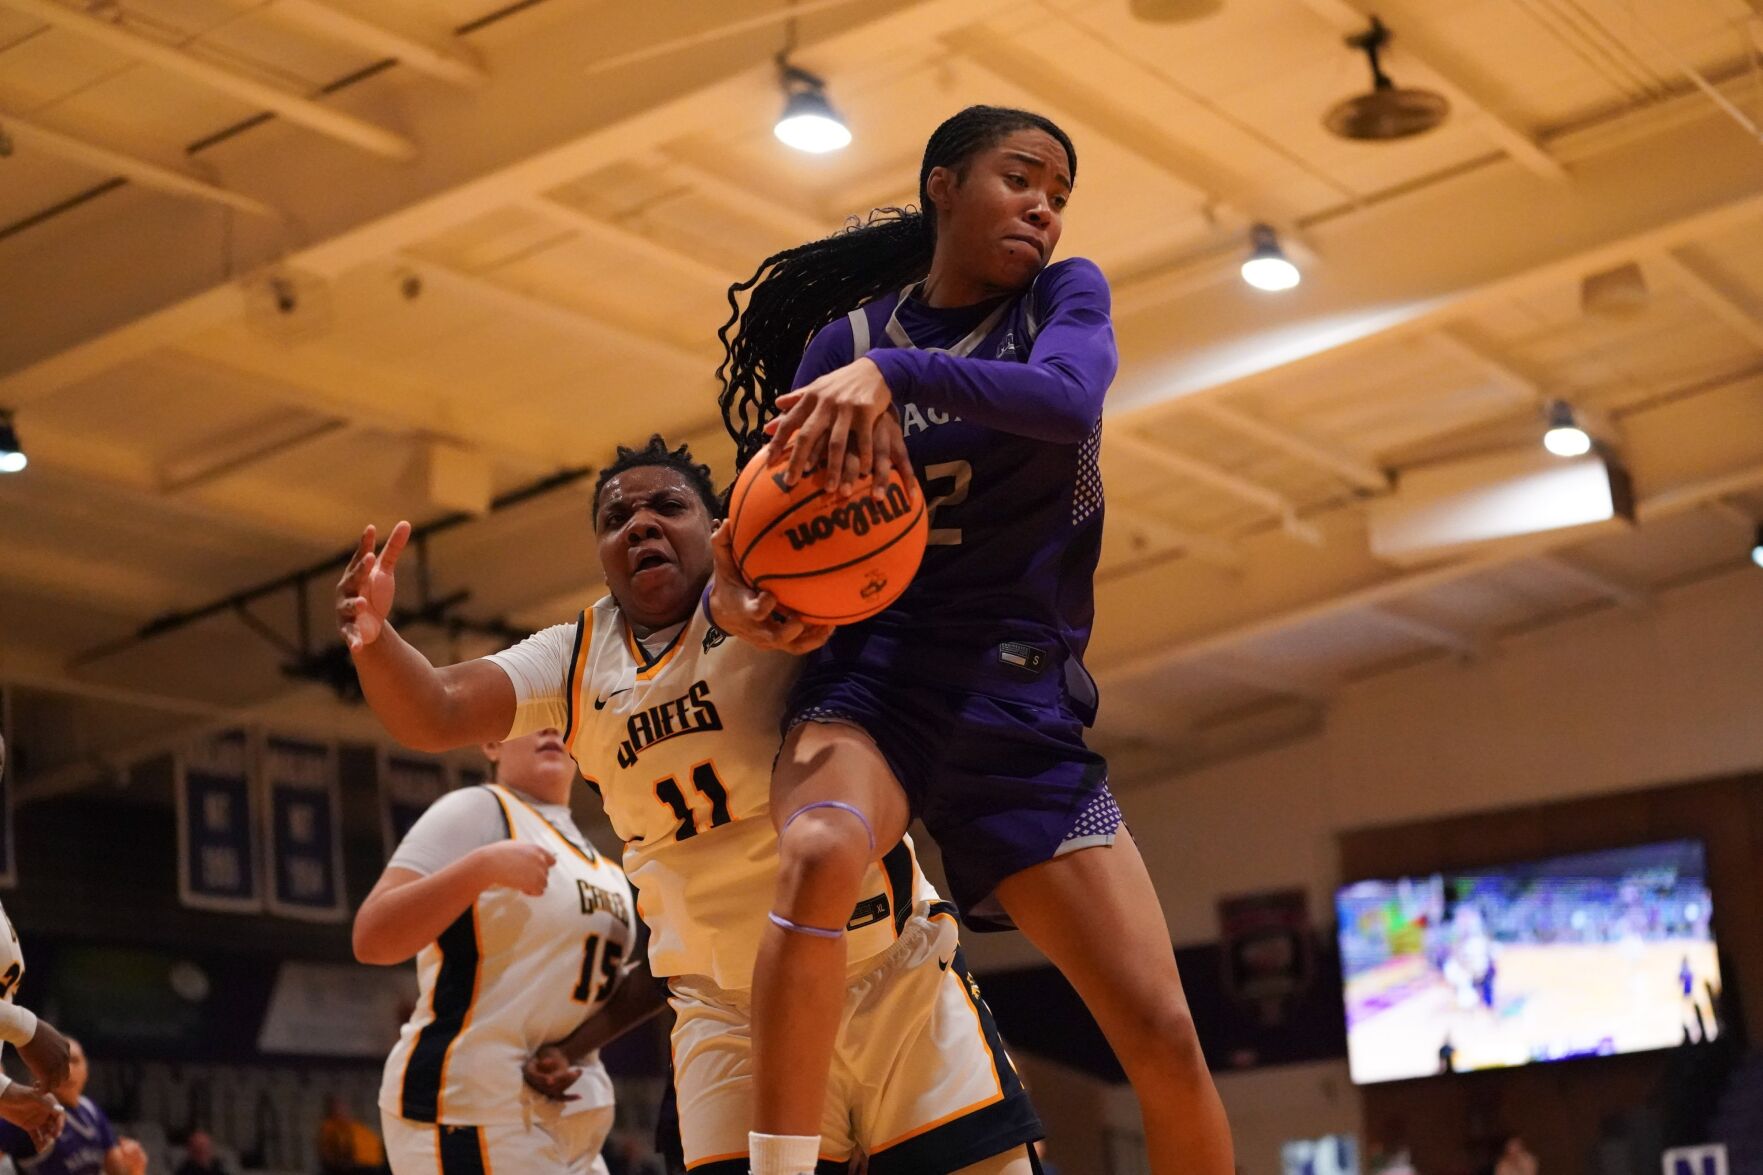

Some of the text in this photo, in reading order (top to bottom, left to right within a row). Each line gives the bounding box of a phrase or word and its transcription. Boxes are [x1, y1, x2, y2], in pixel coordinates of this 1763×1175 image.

[784, 483, 912, 551] Wilson
[1032, 655, 1040, 666] S
[653, 758, 737, 842] 11
[876, 903, 886, 914] XL
[571, 932, 623, 1003] 15
